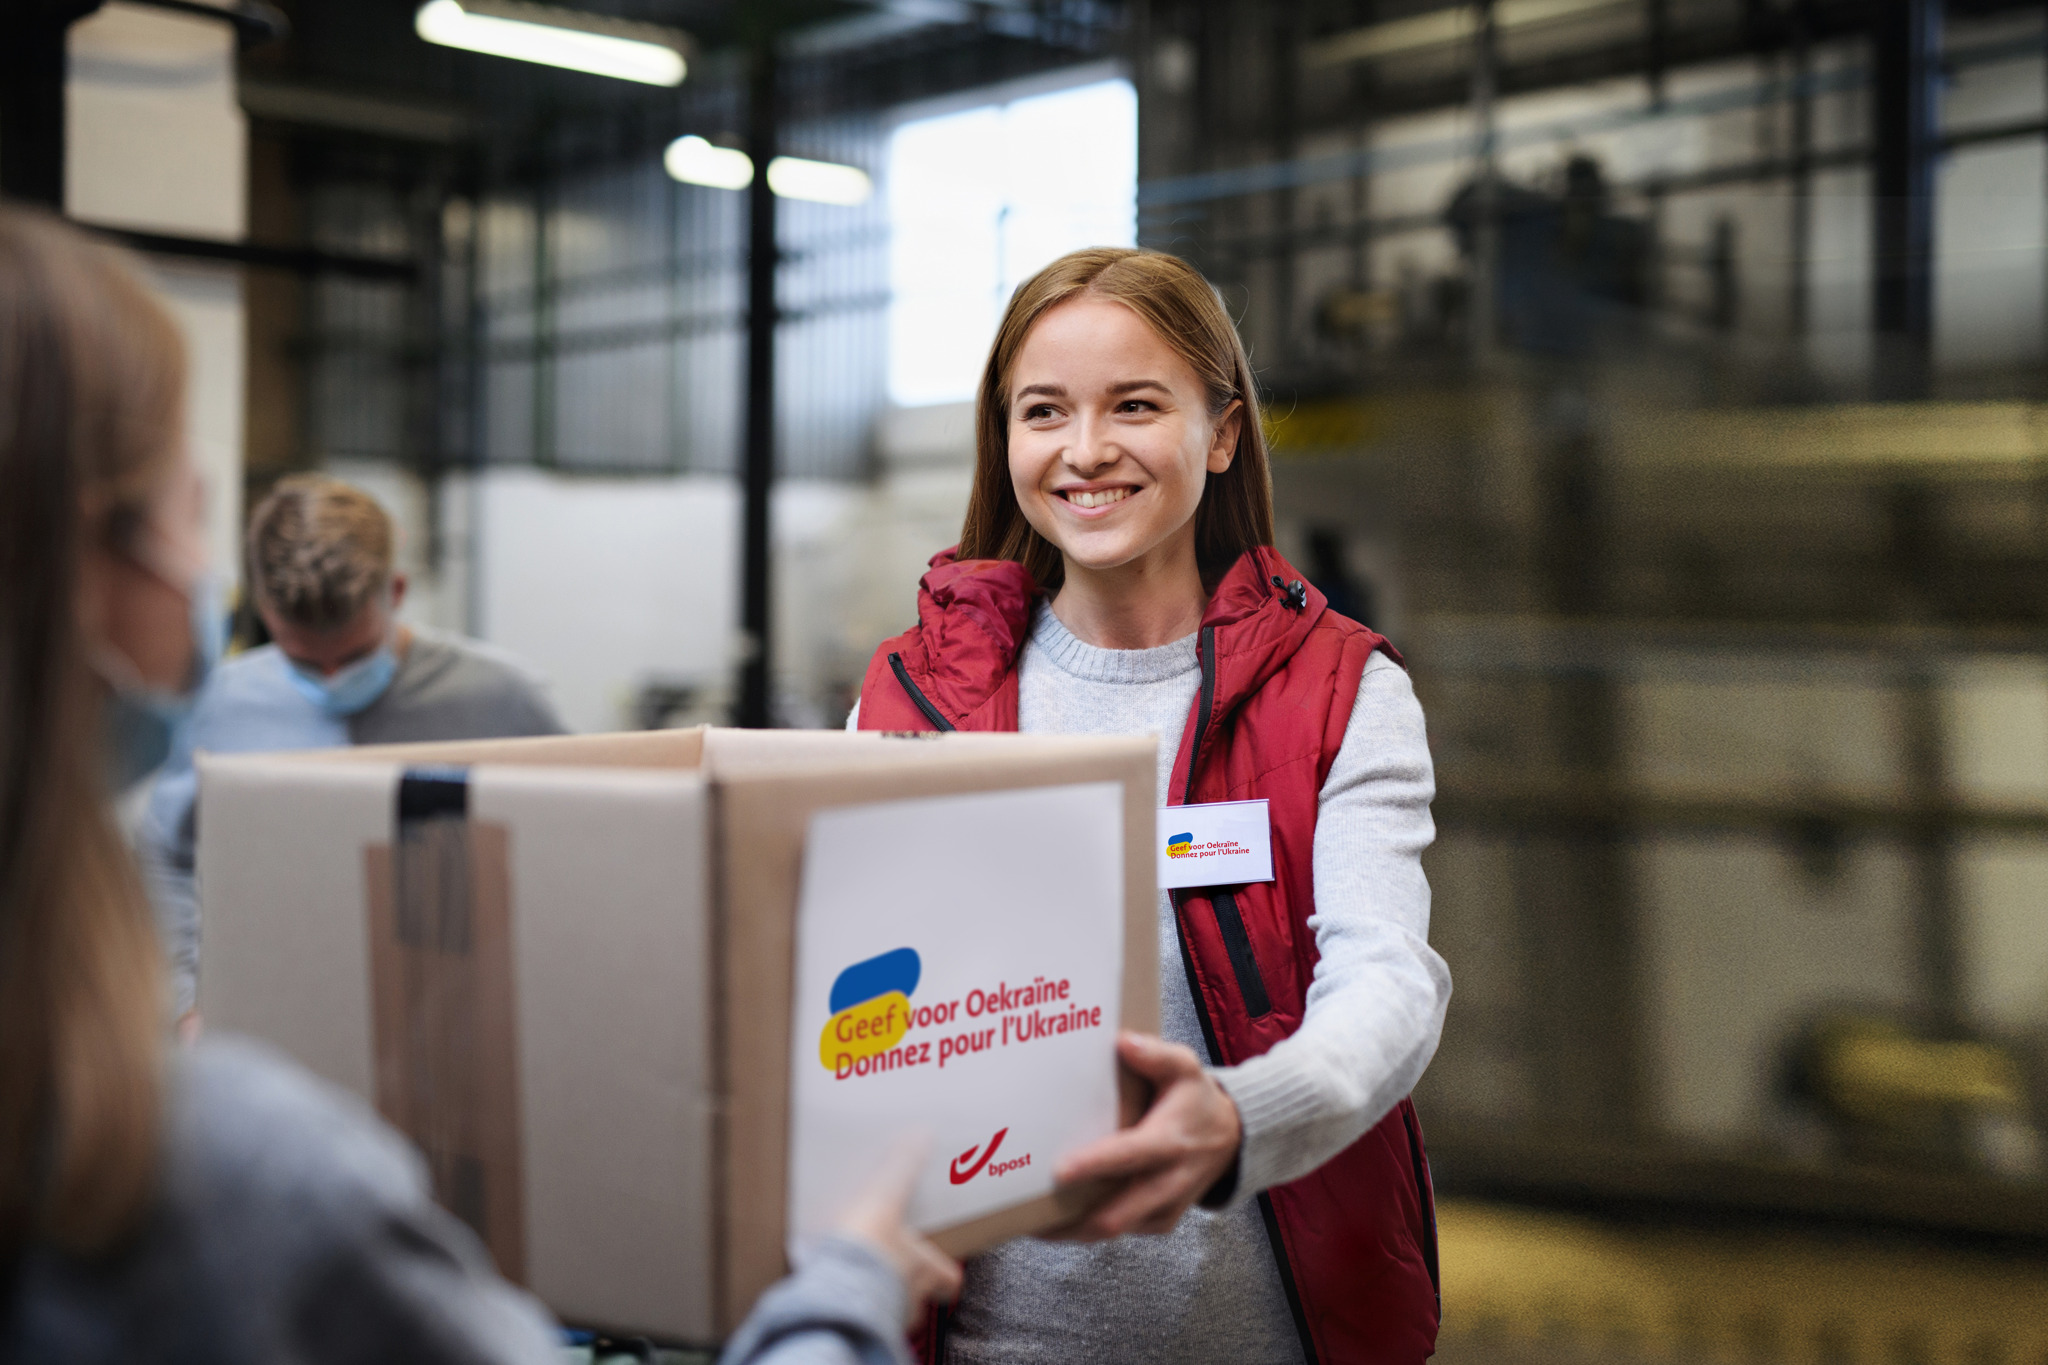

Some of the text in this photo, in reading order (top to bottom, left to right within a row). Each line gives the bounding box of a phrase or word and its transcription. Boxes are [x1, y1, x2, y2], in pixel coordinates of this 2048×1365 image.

[1170, 844, 1188, 852] Geef
[1206, 841, 1239, 849] Oekraïne
[1200, 850, 1216, 859] pour
[1217, 847, 1250, 855] l'Ukraine
[835, 976, 1070, 1043] Geef voor Oekraïne
[835, 1003, 1102, 1080] Donnez pour l'Ukraine
[988, 1153, 1031, 1177] bpost
